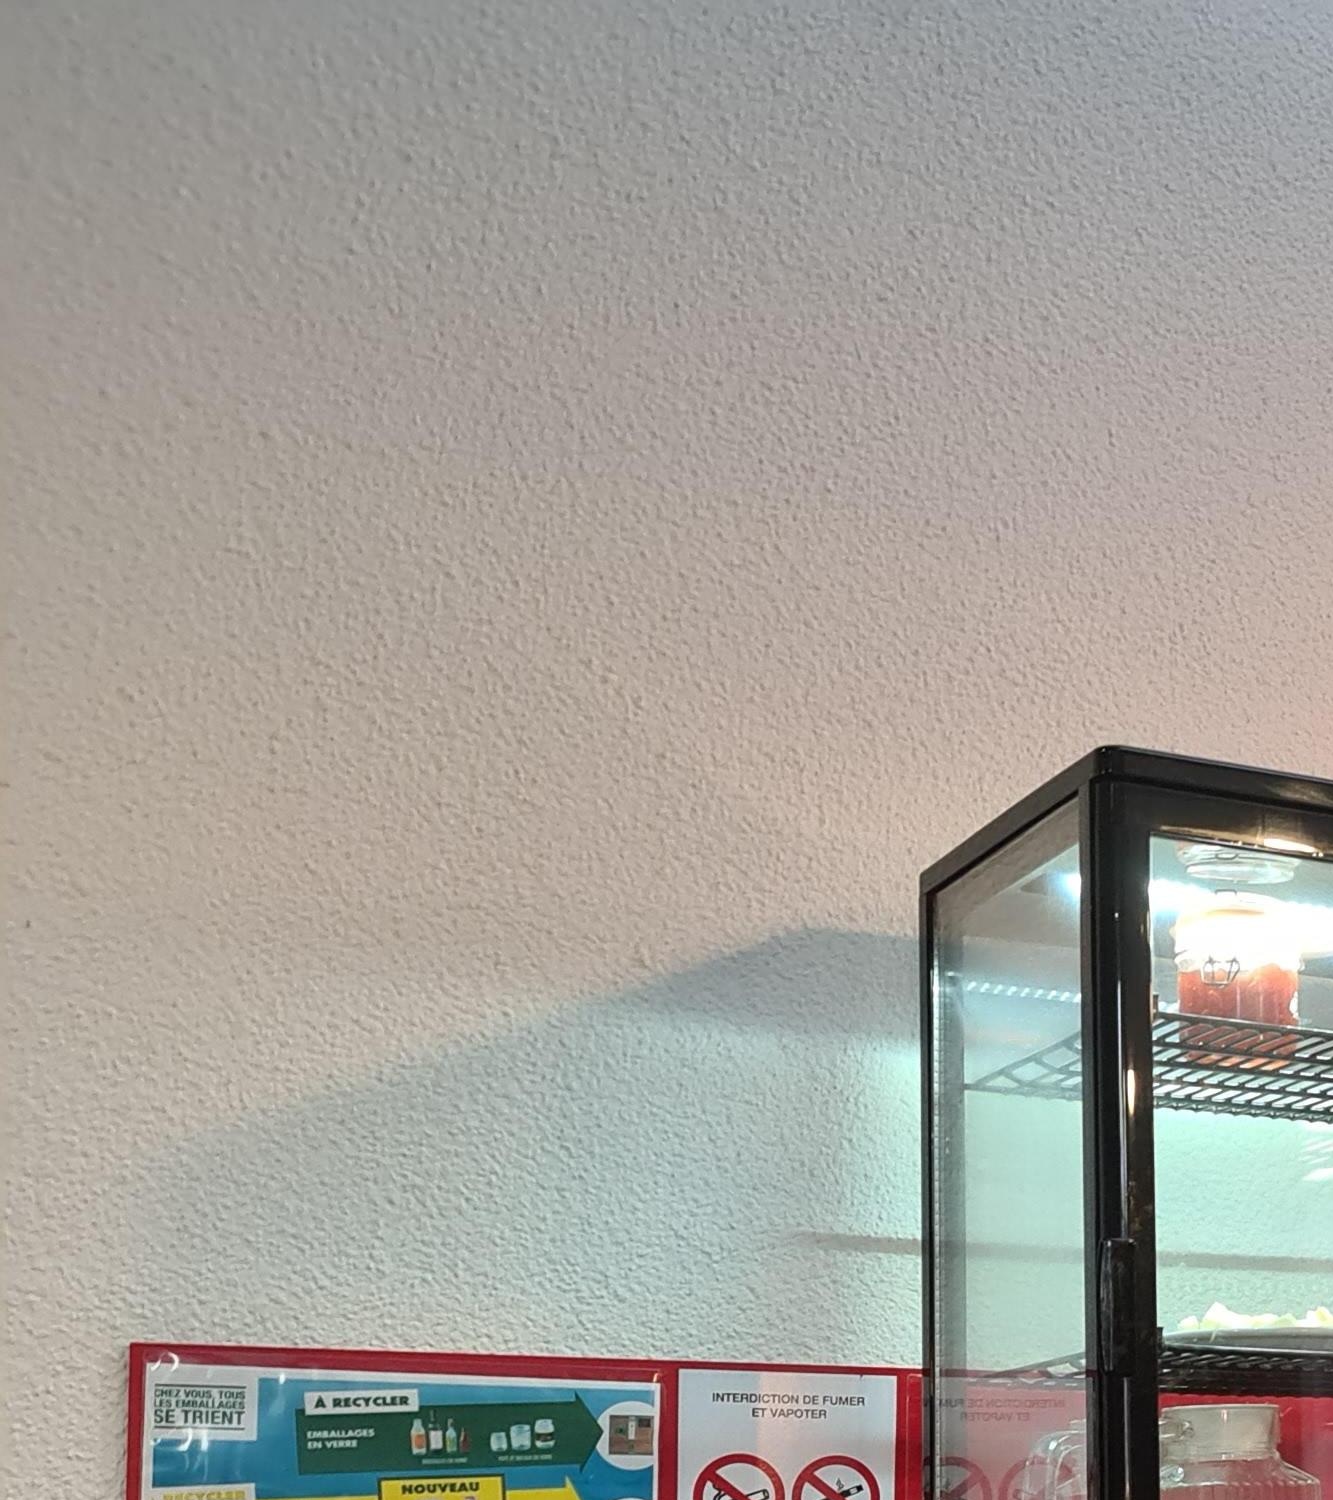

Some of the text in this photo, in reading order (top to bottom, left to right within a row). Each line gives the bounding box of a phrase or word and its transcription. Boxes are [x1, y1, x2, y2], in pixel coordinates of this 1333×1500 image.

[154, 1388, 180, 1399] CHEZ
[219, 1390, 246, 1399] TOUS
[712, 1392, 866, 1406] INTERDICTION DE FUMER
[154, 1399, 246, 1410] LES EMBALLAGES
[332, 1396, 409, 1408] RECYCLER
[154, 1409, 246, 1426] SE TRIENT
[752, 1407, 827, 1419] ET VAPOTER
[306, 1428, 376, 1440] EMBALLAGES
[324, 1440, 358, 1449] VERRE
[402, 1482, 480, 1495] NOUVEAU
